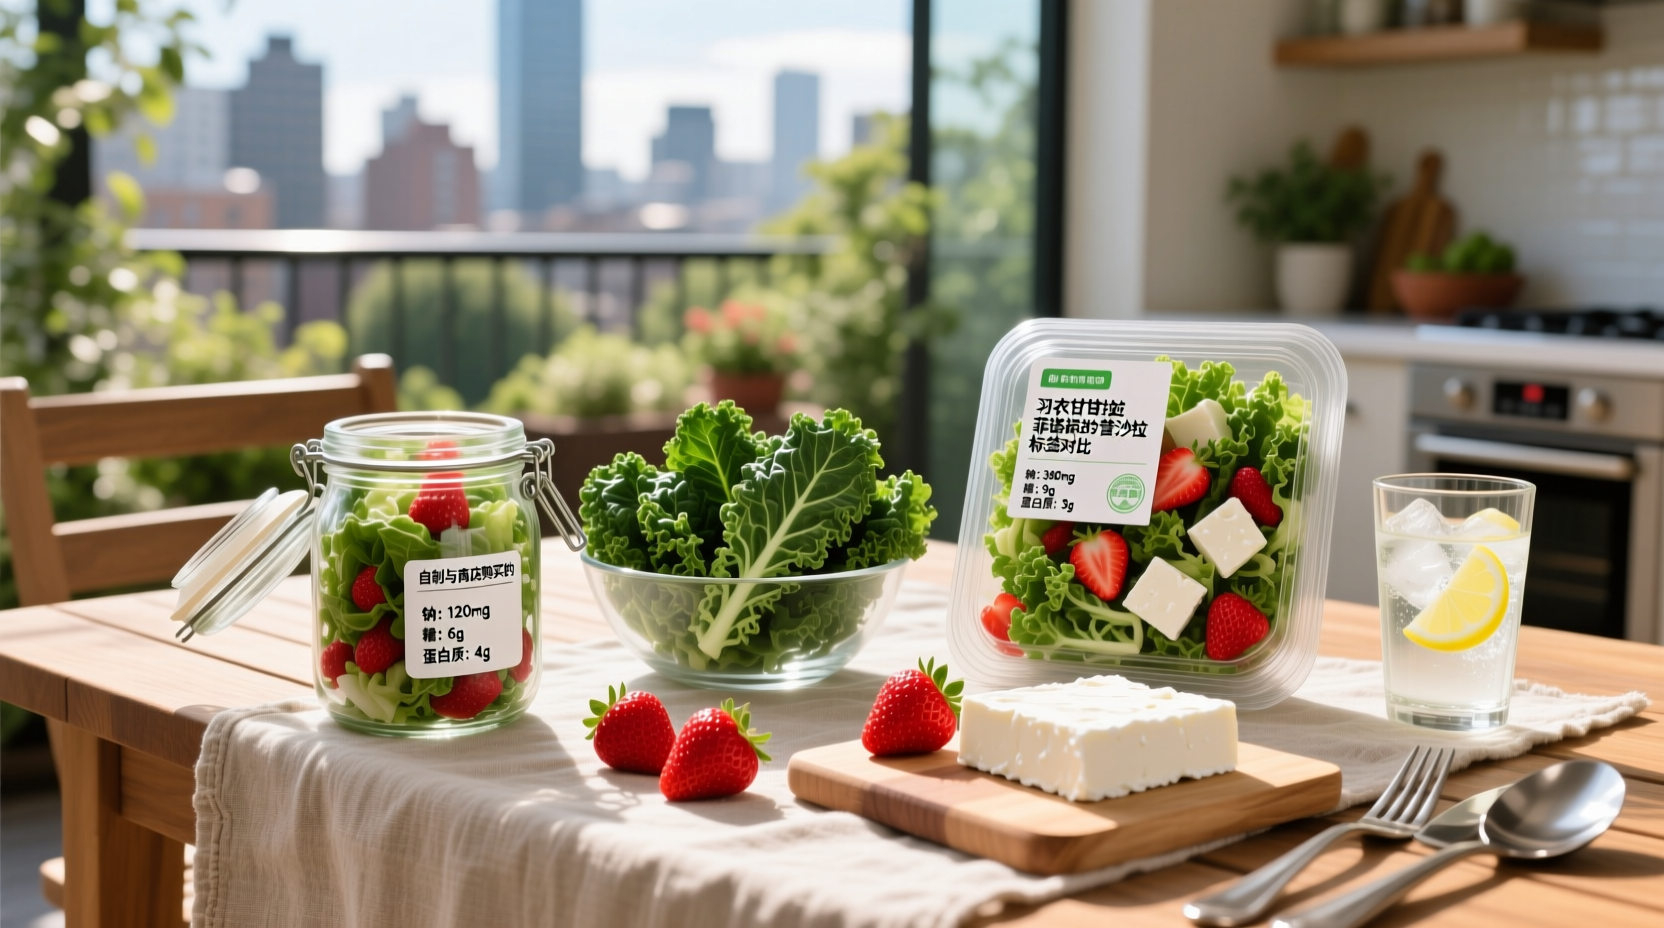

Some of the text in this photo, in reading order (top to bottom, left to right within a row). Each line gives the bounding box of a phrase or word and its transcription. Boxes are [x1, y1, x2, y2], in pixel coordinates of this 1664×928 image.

[447, 604, 491, 620] 120mg
[447, 627, 465, 642] 6g
[423, 645, 491, 665] 蛋白质： 4g
